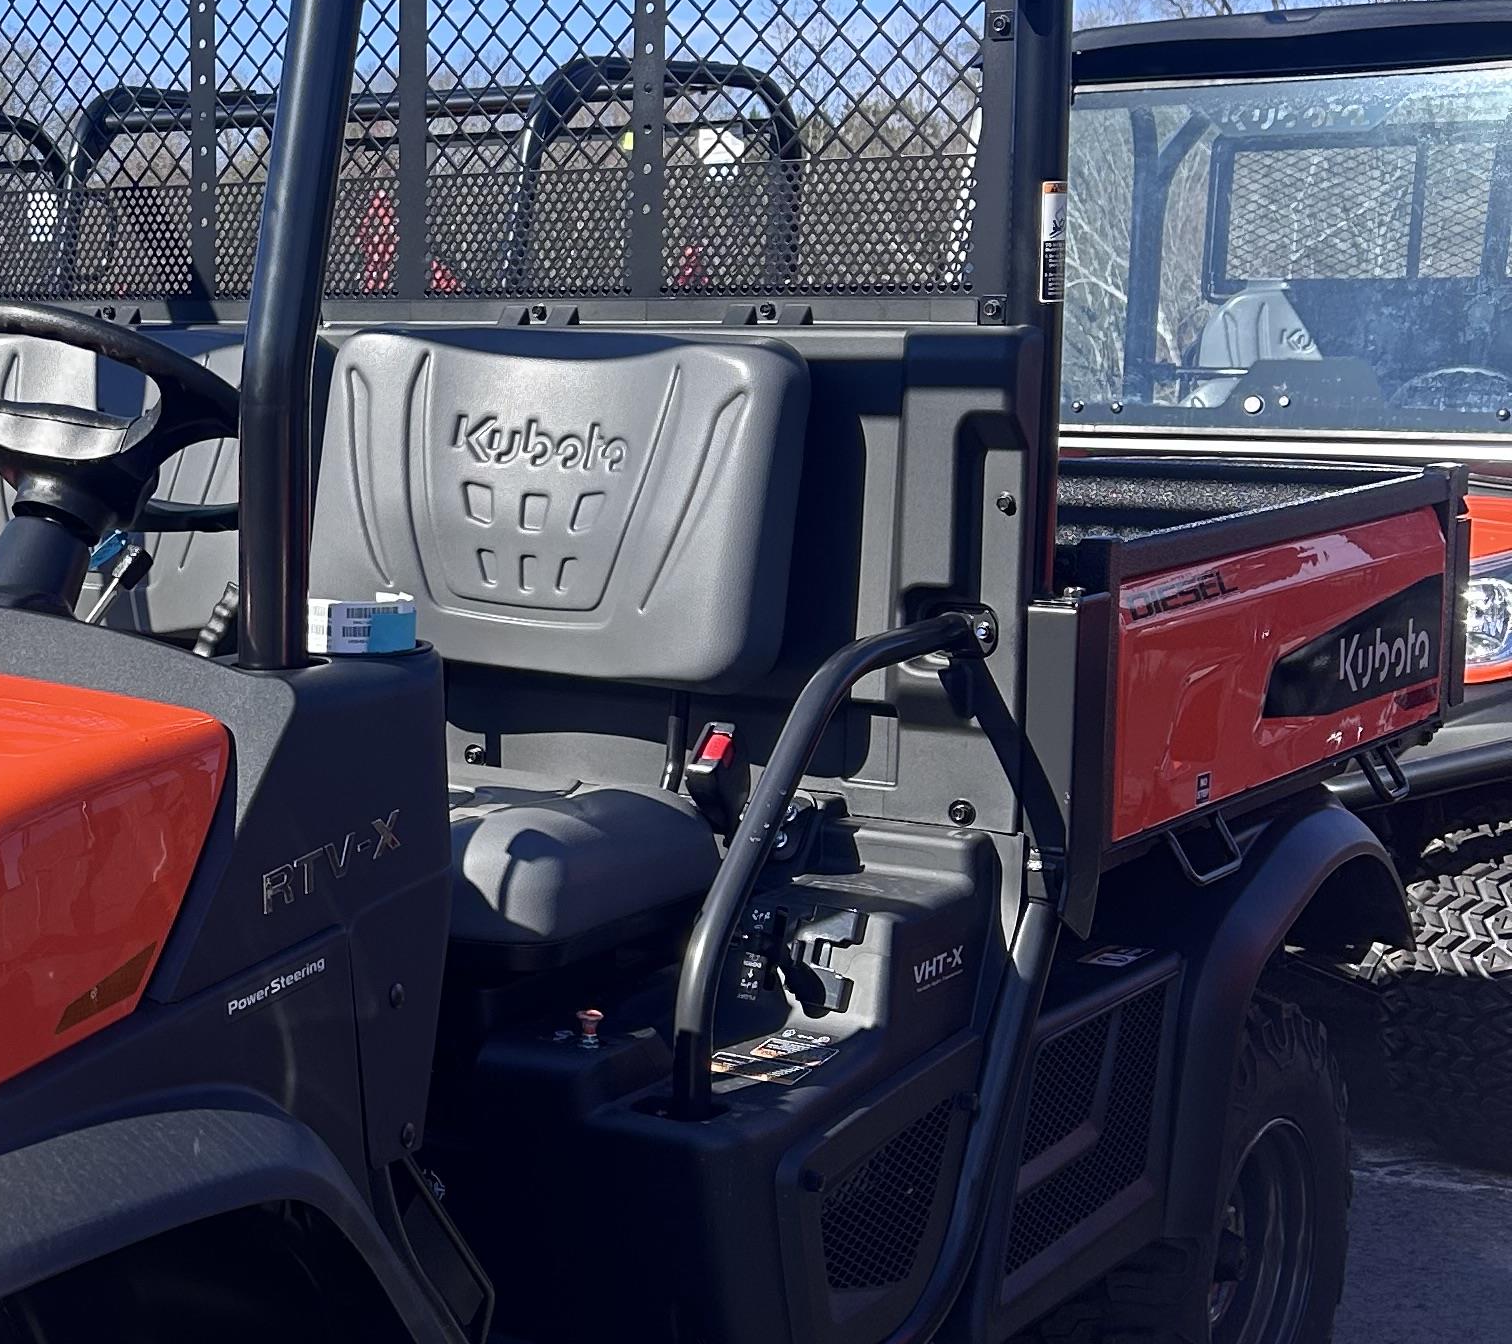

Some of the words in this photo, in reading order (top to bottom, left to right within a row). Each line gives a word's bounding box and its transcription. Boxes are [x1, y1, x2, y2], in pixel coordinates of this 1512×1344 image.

[451, 413, 628, 473] Kubota
[1128, 569, 1239, 621] DIESEL
[1339, 618, 1430, 692] Kubota
[262, 809, 401, 915] RTV-X
[914, 945, 964, 984] VHT-X
